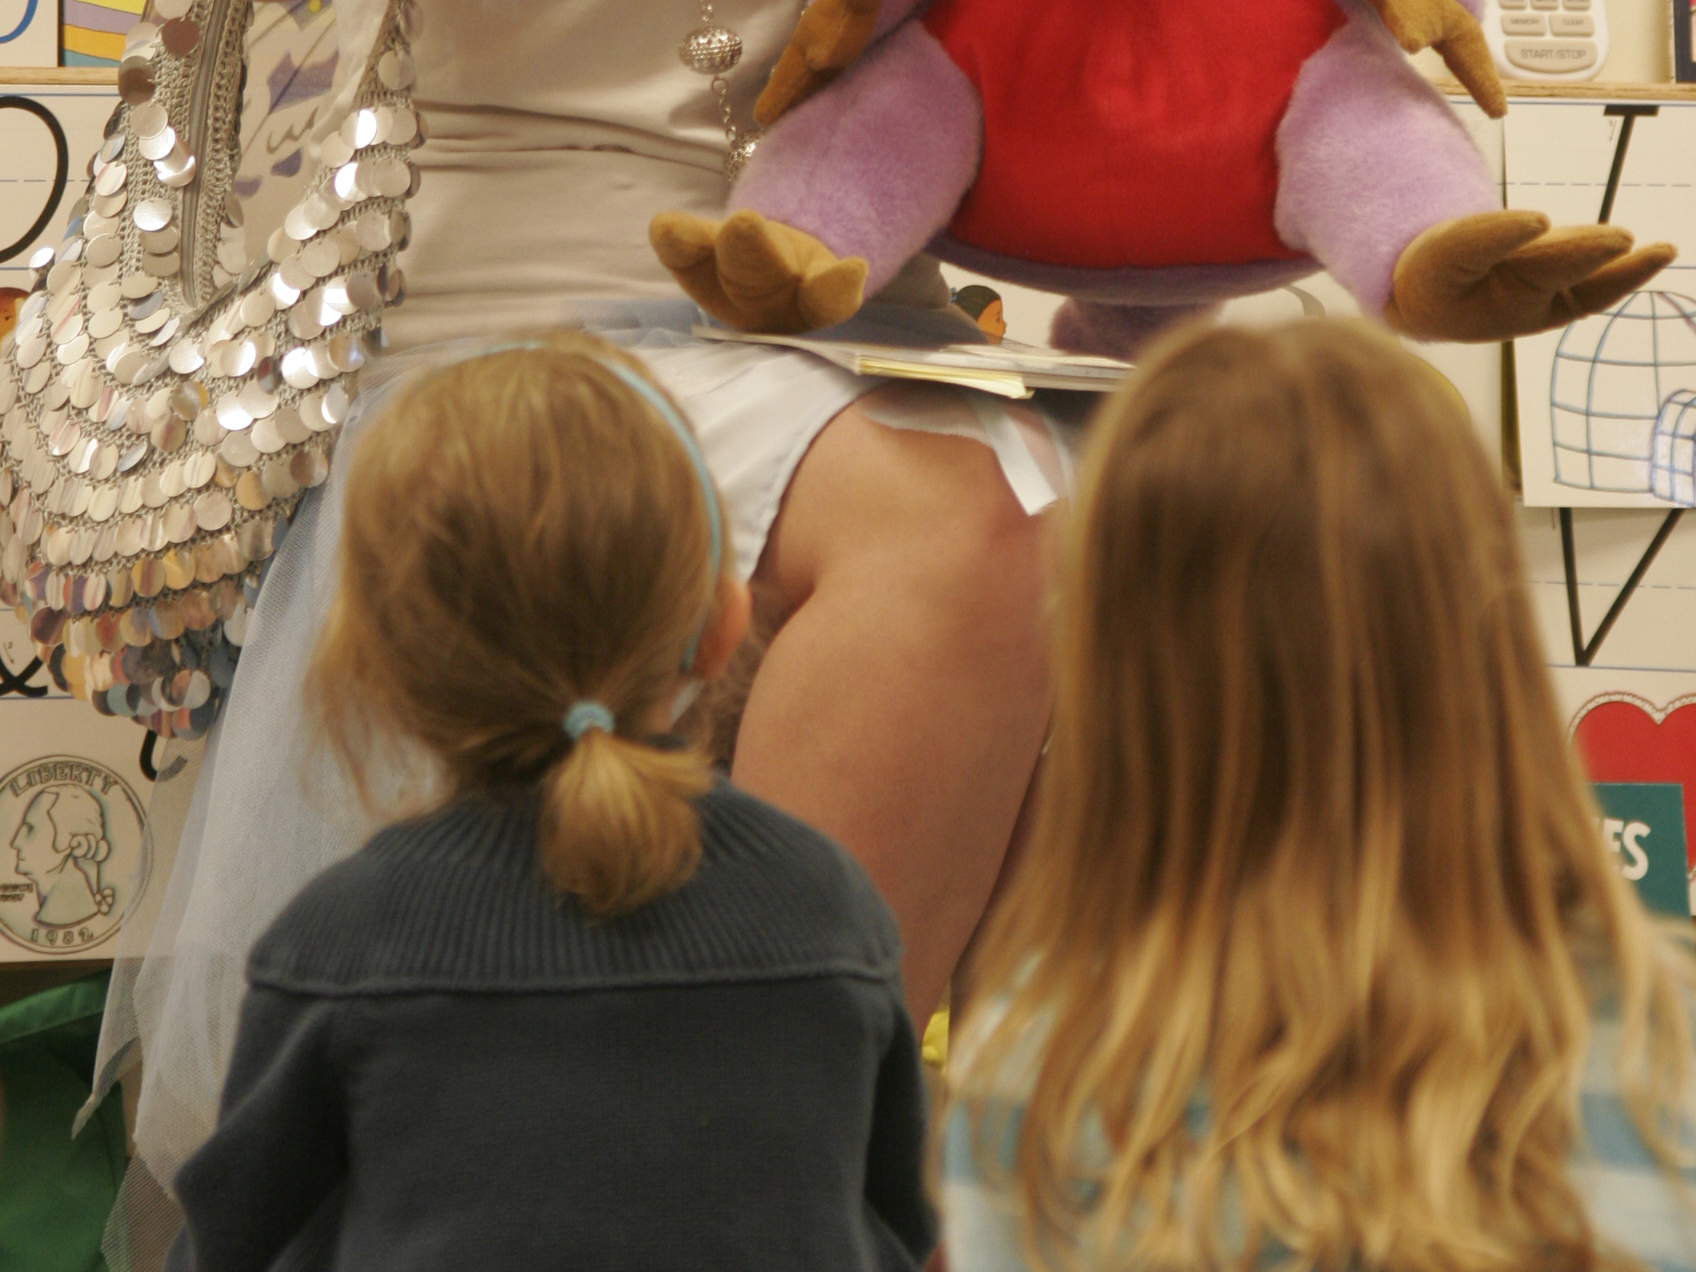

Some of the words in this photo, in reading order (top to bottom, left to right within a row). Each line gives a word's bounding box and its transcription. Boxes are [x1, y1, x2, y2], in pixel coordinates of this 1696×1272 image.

[1520, 49, 1587, 59] START/STOP
[9, 761, 119, 798] LIBERTY
[31, 928, 94, 946] 1982
